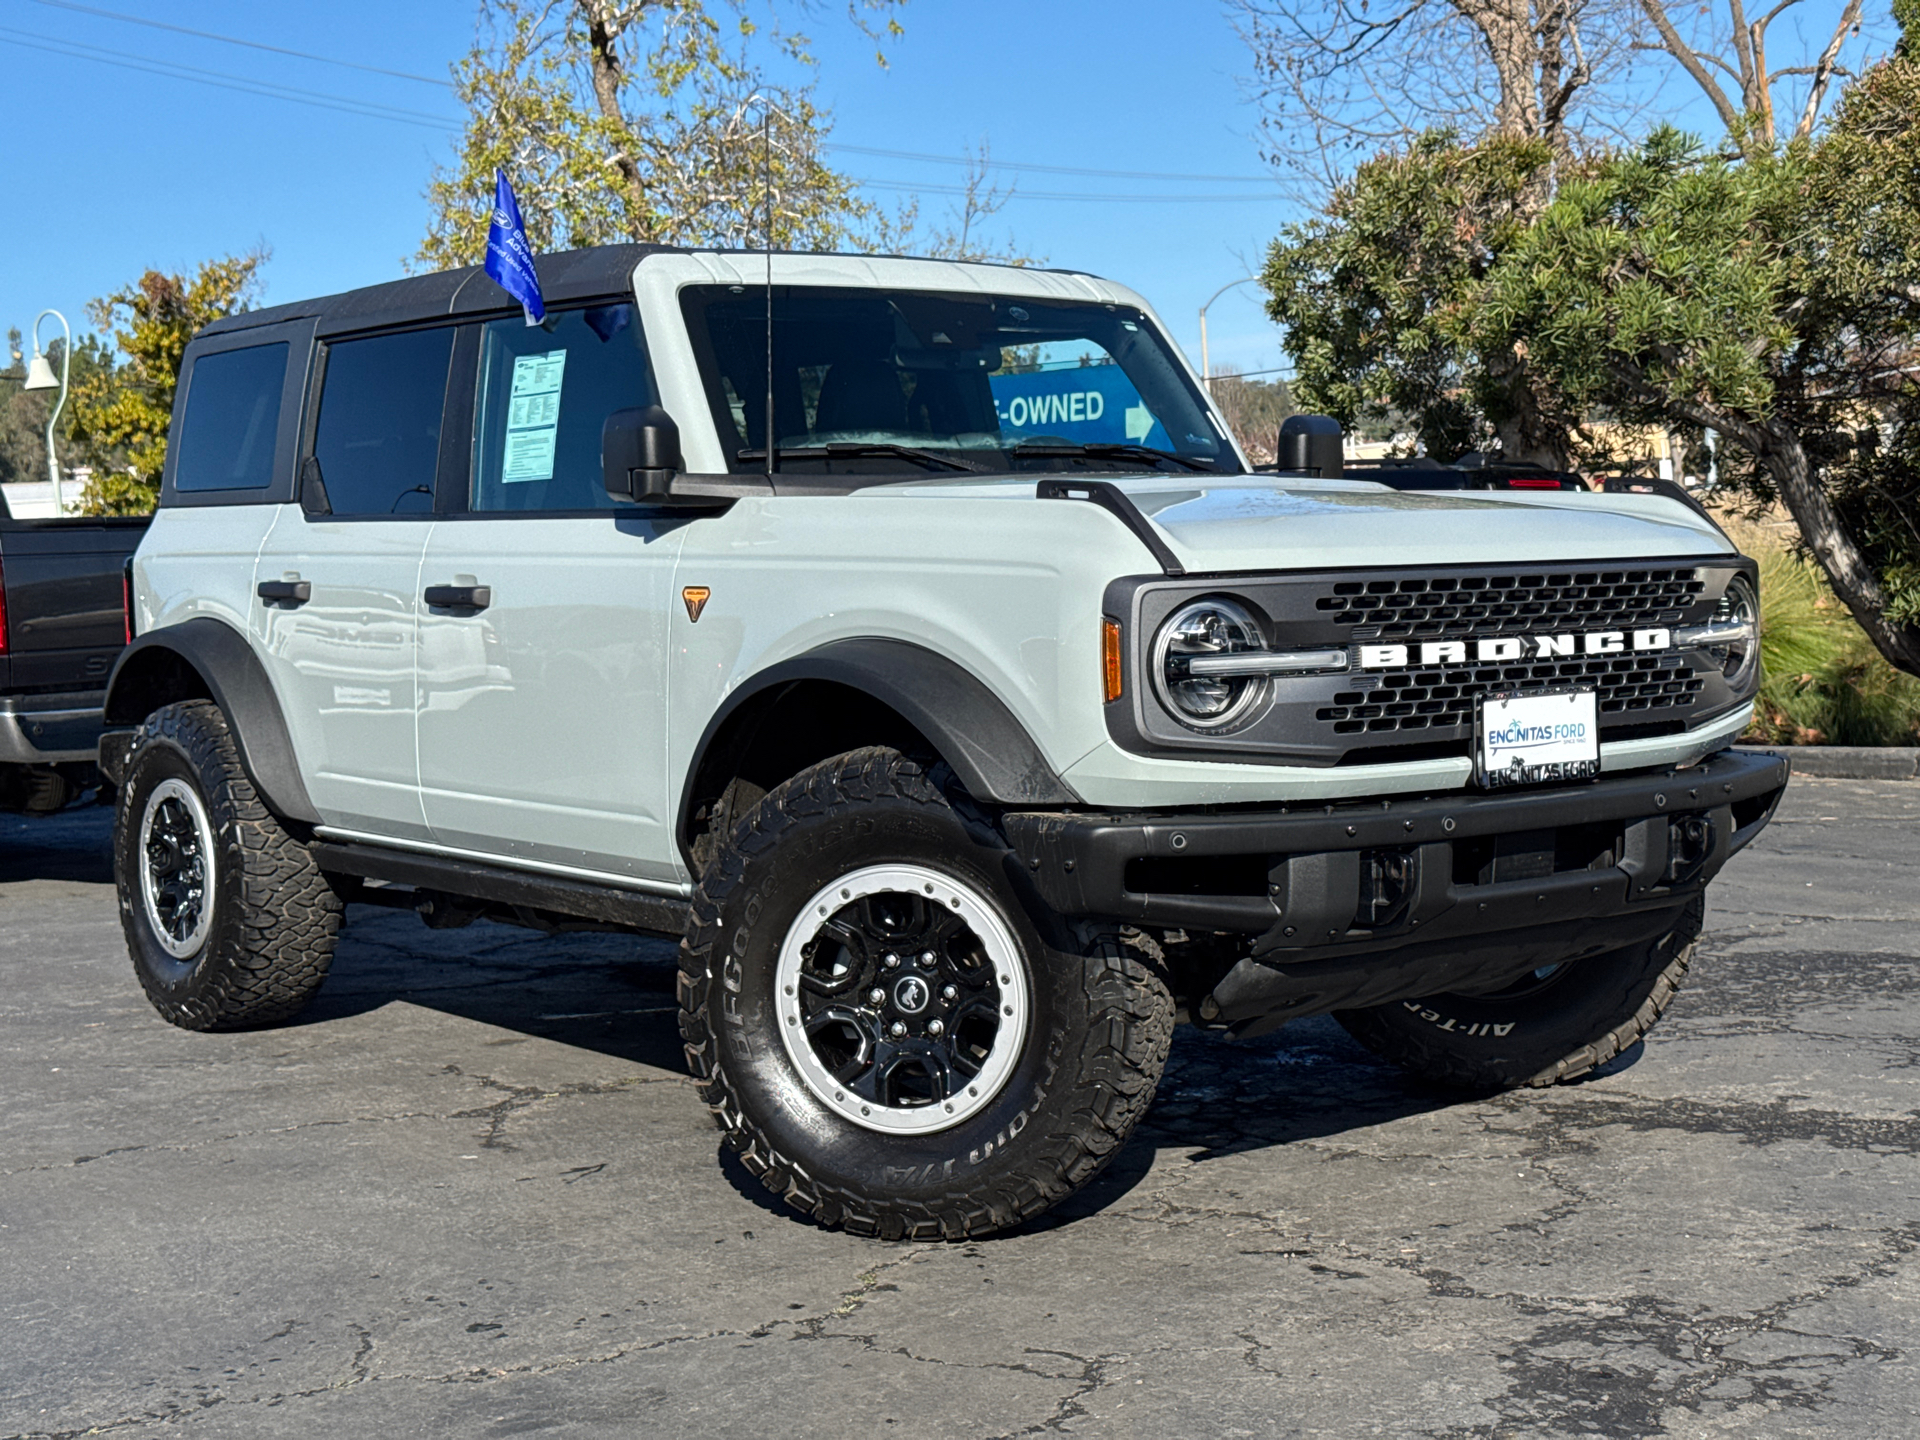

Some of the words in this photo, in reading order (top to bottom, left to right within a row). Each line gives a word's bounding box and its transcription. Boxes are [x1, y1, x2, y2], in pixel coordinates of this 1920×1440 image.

[512, 229, 530, 253] Blue
[505, 254, 523, 272] Used
[506, 237, 539, 285] Advanta
[994, 391, 1104, 427] -OWNED
[1361, 628, 1670, 669] BRONCO
[1488, 725, 1552, 745] ENCINITAS
[1554, 722, 1586, 740] FORD
[1562, 760, 1596, 779] FORD
